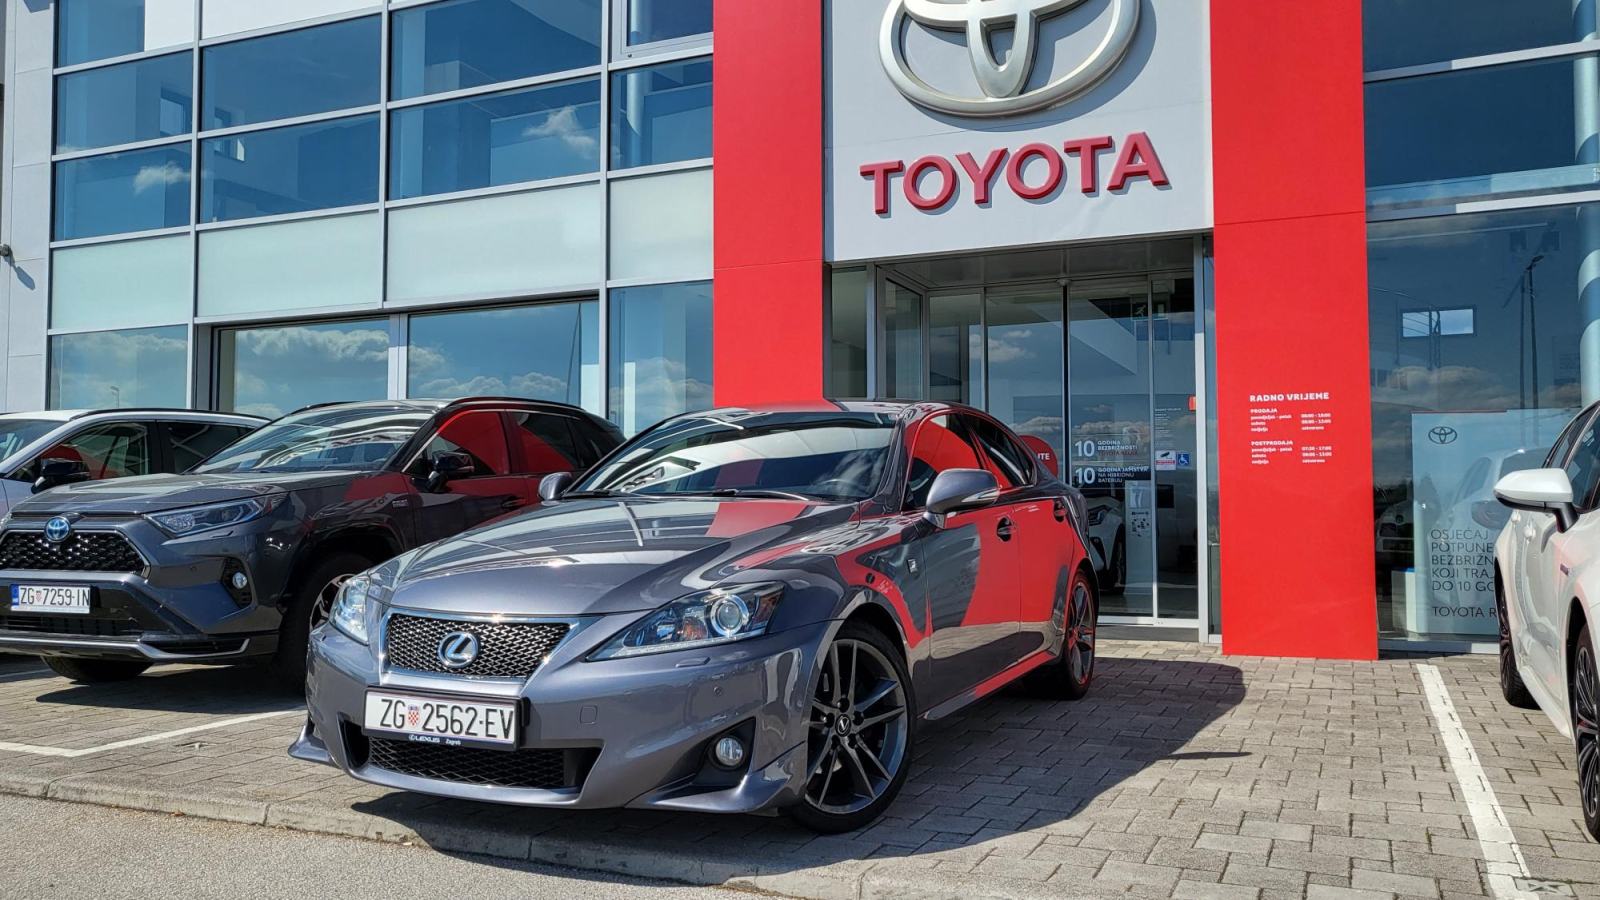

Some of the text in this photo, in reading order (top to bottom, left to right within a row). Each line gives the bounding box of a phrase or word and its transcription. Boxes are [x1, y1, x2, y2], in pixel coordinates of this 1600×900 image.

[859, 131, 1169, 215] TOYOTA
[1249, 392, 1330, 402] RADNO VRIJEME
[1074, 440, 1095, 457] 10
[1075, 467, 1096, 485] 10
[1431, 542, 1493, 553] POTPUNE
[1431, 553, 1494, 566] BEZBRIŽN
[1432, 567, 1494, 579] KOJI TRA
[1432, 580, 1495, 592] DO 10 GO
[20, 587, 90, 606] ZG 7259-IN
[1431, 606, 1498, 618] TOYOTA R
[380, 698, 514, 739] ZG 2562-EV
[415, 735, 440, 743] LEXUS
